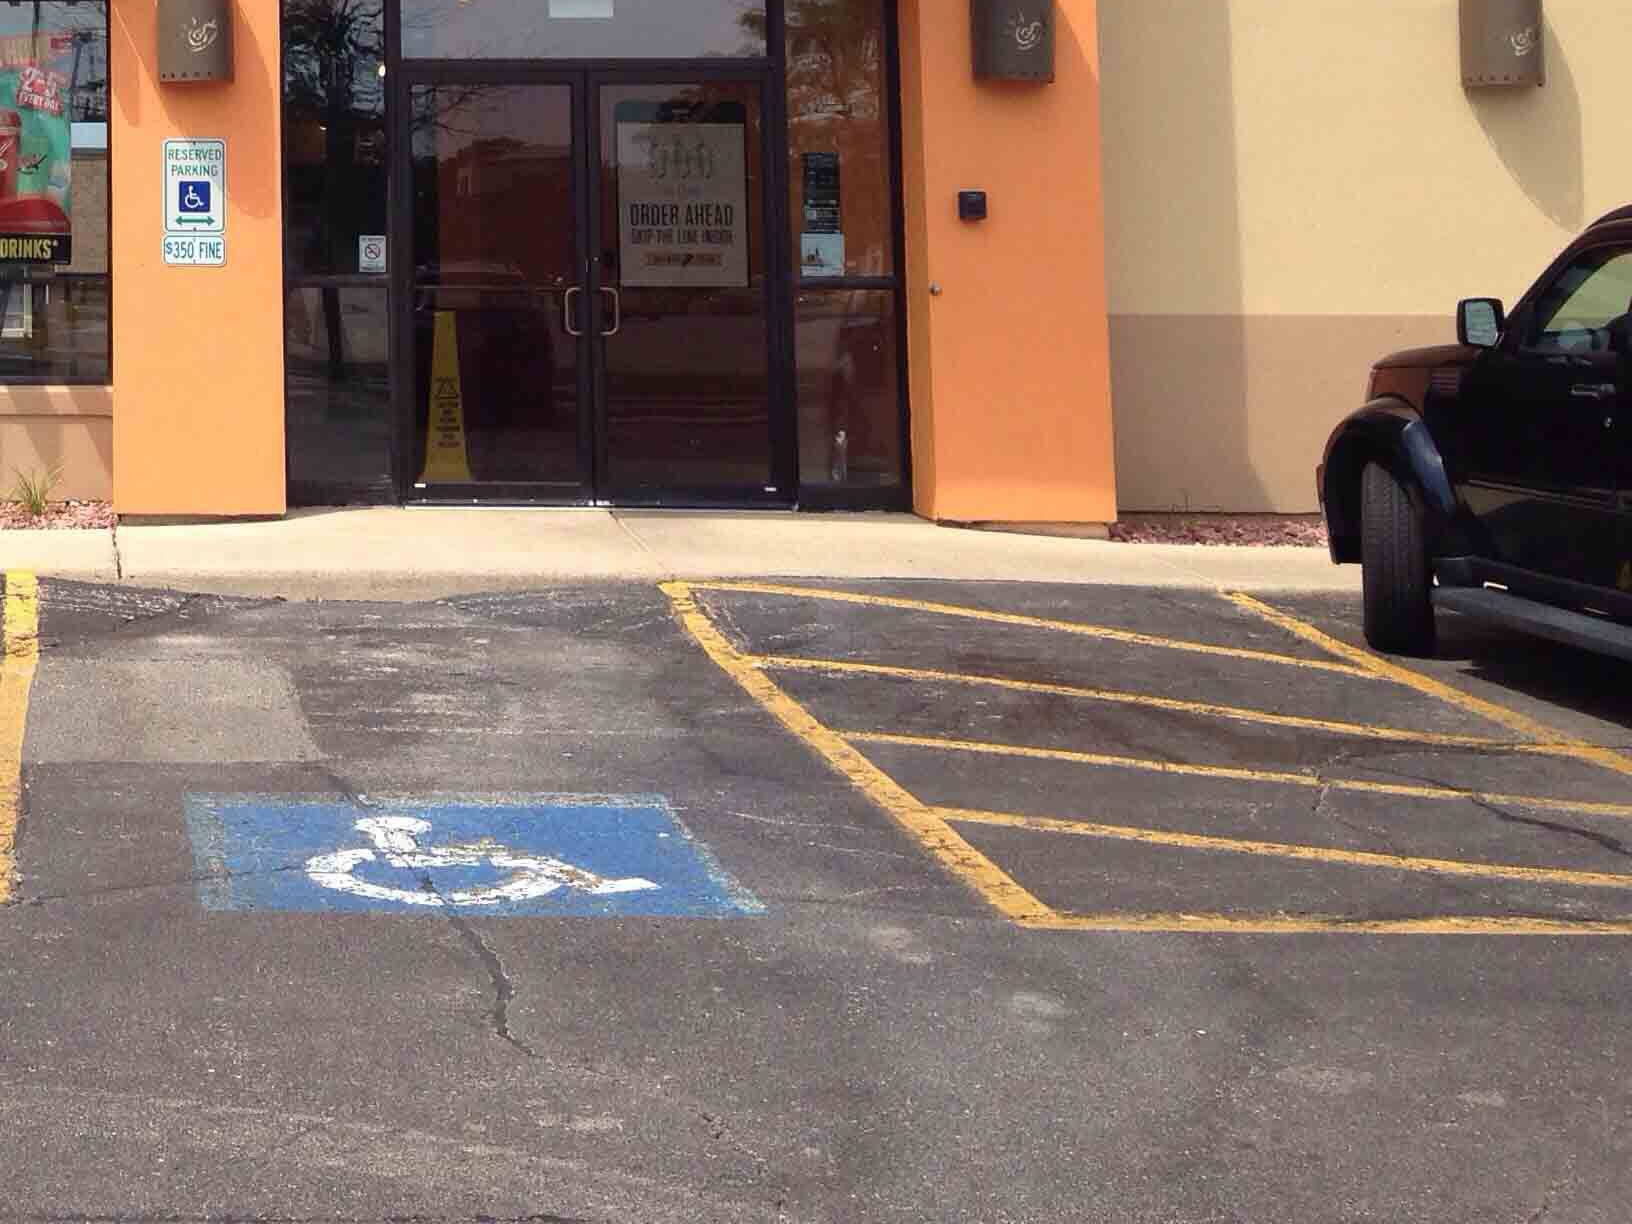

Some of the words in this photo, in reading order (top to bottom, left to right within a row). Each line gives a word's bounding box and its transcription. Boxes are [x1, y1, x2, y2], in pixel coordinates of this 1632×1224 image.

[168, 149, 222, 161] RESERVED
[171, 164, 219, 176] PARKING
[630, 203, 679, 226] ORDER
[686, 203, 734, 226] AHEAD
[165, 241, 194, 258] $350
[199, 241, 222, 259] FINE
